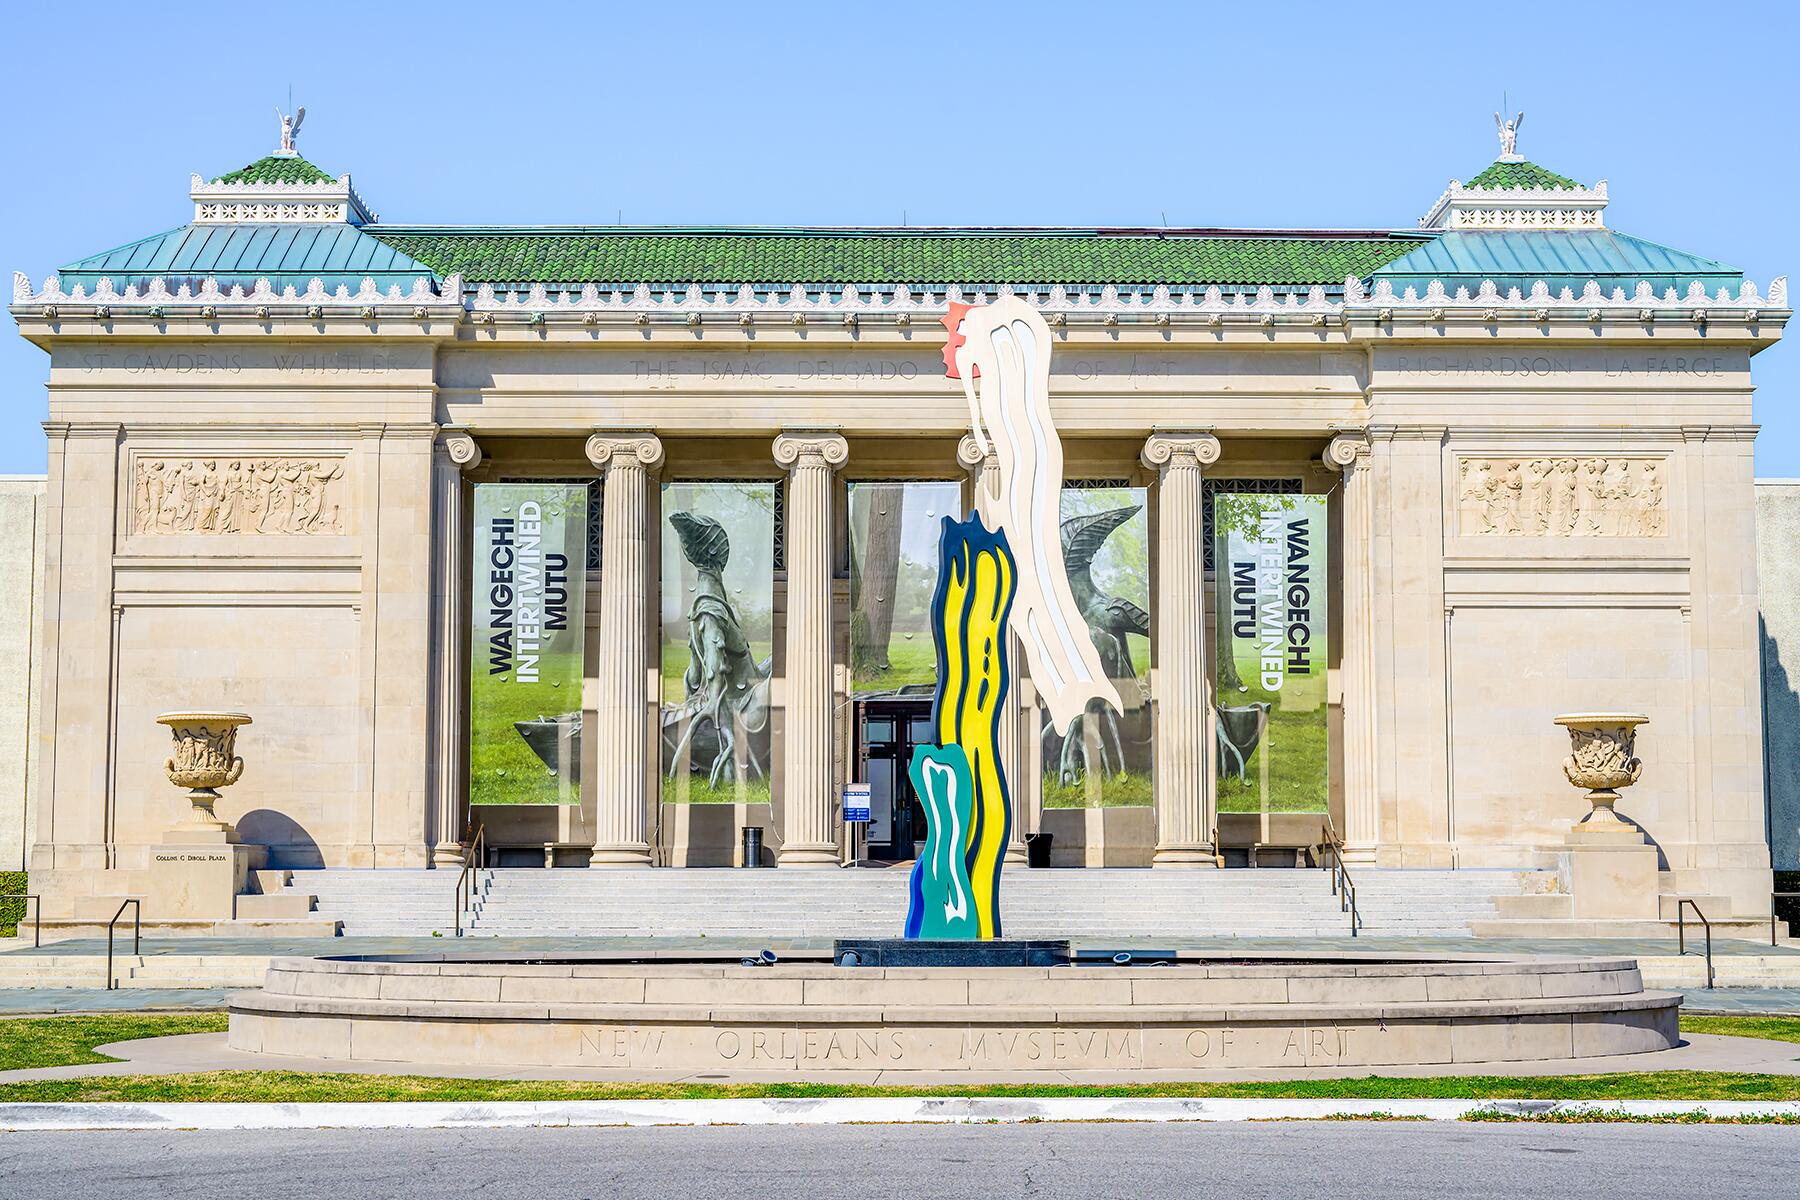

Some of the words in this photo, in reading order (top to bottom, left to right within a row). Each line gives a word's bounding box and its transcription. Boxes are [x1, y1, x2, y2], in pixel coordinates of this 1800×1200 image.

[82, 354, 108, 374] ST
[272, 354, 401, 375] WHISTLER
[630, 360, 679, 381] THE
[702, 360, 773, 381] ISAAC
[797, 360, 918, 381] DELGADO
[1073, 361, 1104, 381] OF
[1397, 356, 1572, 377] RICHARDSON
[1604, 357, 1632, 378] LA
[1646, 357, 1724, 378] FARGE
[489, 518, 515, 676] WANGECHI
[516, 500, 542, 683] INTERTWINED
[544, 553, 569, 631] MUTU
[1233, 562, 1256, 639] MUTU
[1260, 511, 1284, 692] INTERTWINED
[1287, 518, 1311, 674] WANGECHI
[579, 1029, 665, 1057] NEW
[715, 1030, 905, 1060] ORLEANS
[1185, 1029, 1235, 1058] OF
[1282, 1028, 1356, 1057] ART
